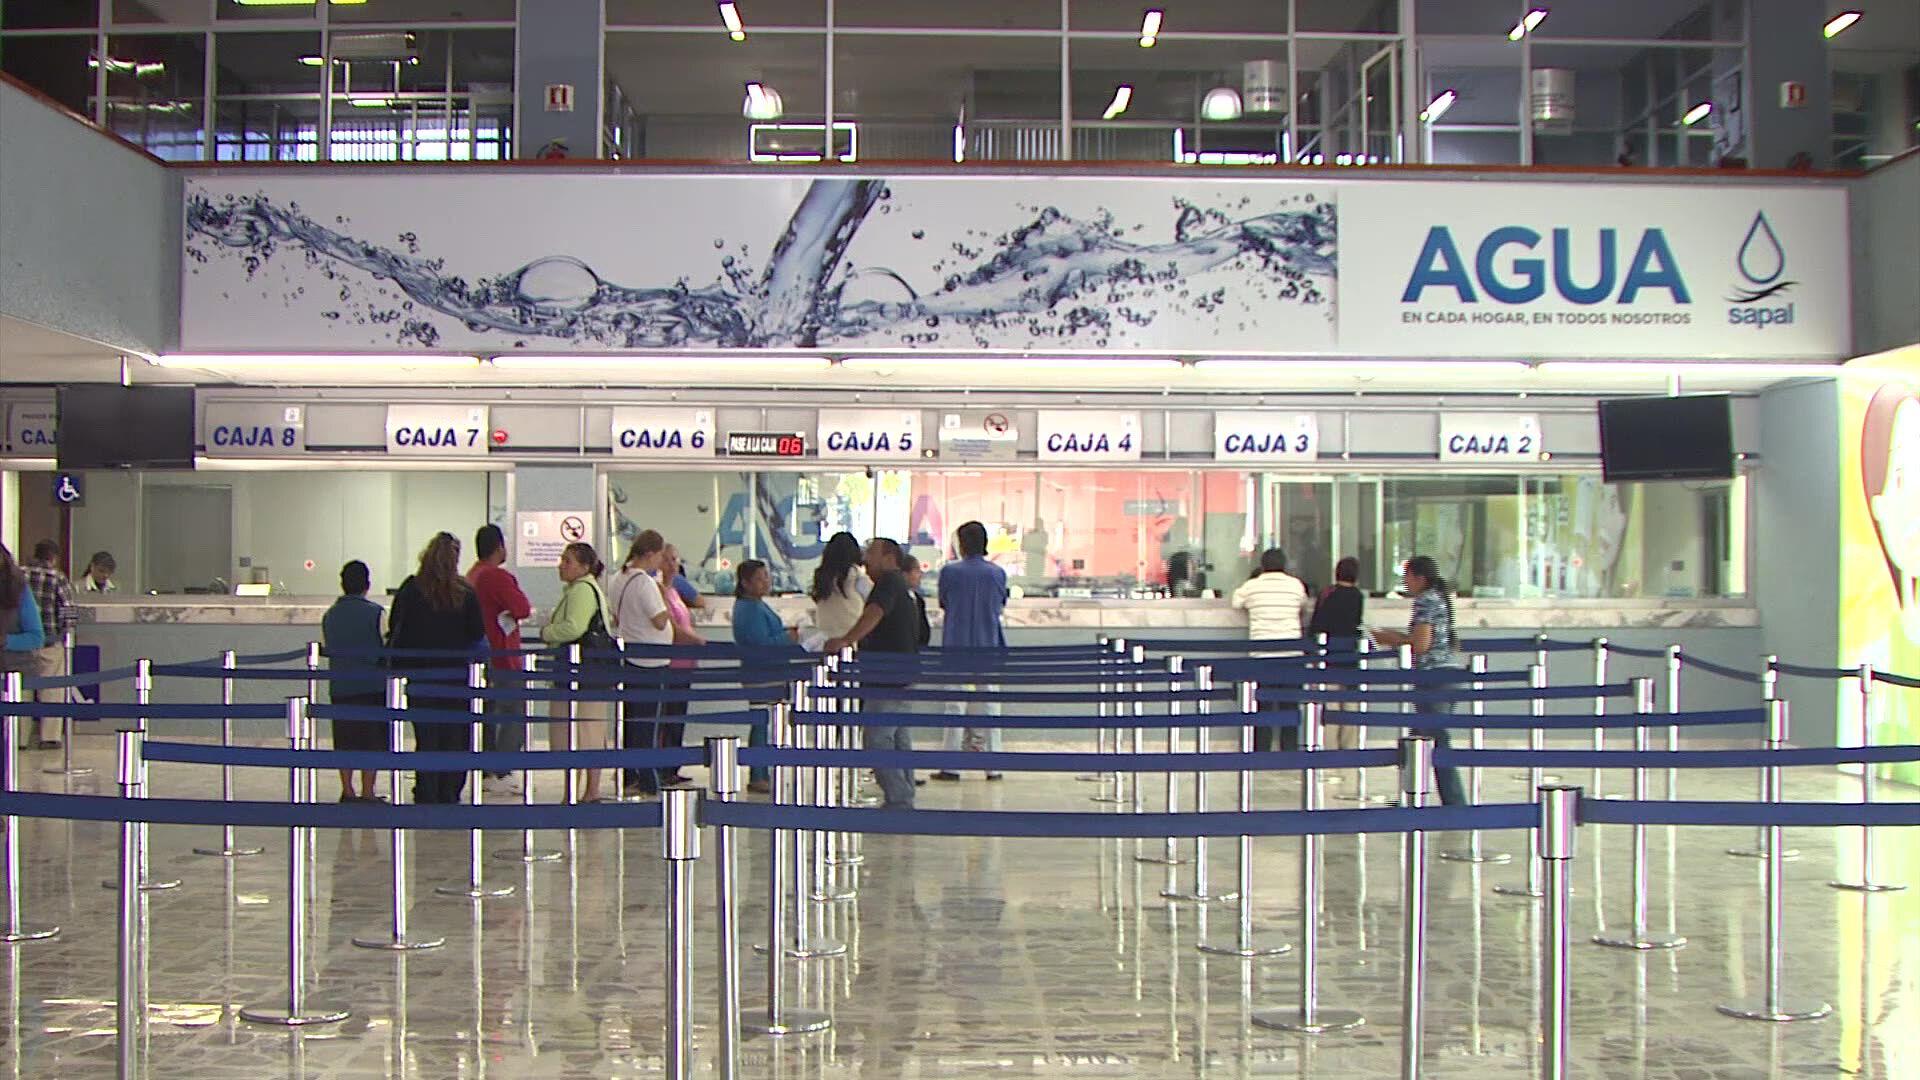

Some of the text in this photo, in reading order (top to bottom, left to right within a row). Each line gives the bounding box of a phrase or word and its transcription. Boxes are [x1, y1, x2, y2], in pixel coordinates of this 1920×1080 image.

[1401, 226, 1691, 304] AGUA
[1402, 312, 1691, 326] EN CADA HOGAR, EN TODOS NOSOTROS
[1728, 302, 1794, 329] sapal
[22, 429, 57, 445] CAJ
[214, 427, 295, 446] CAJA 8
[396, 428, 479, 447] CAJA 7
[620, 430, 704, 449] CAJA 6
[779, 438, 802, 454] 06
[828, 431, 912, 451] CAJA 5
[1048, 433, 1132, 452] CAJA 4
[1225, 434, 1309, 453] CAJA 3
[1449, 435, 1532, 453] CAJA 2
